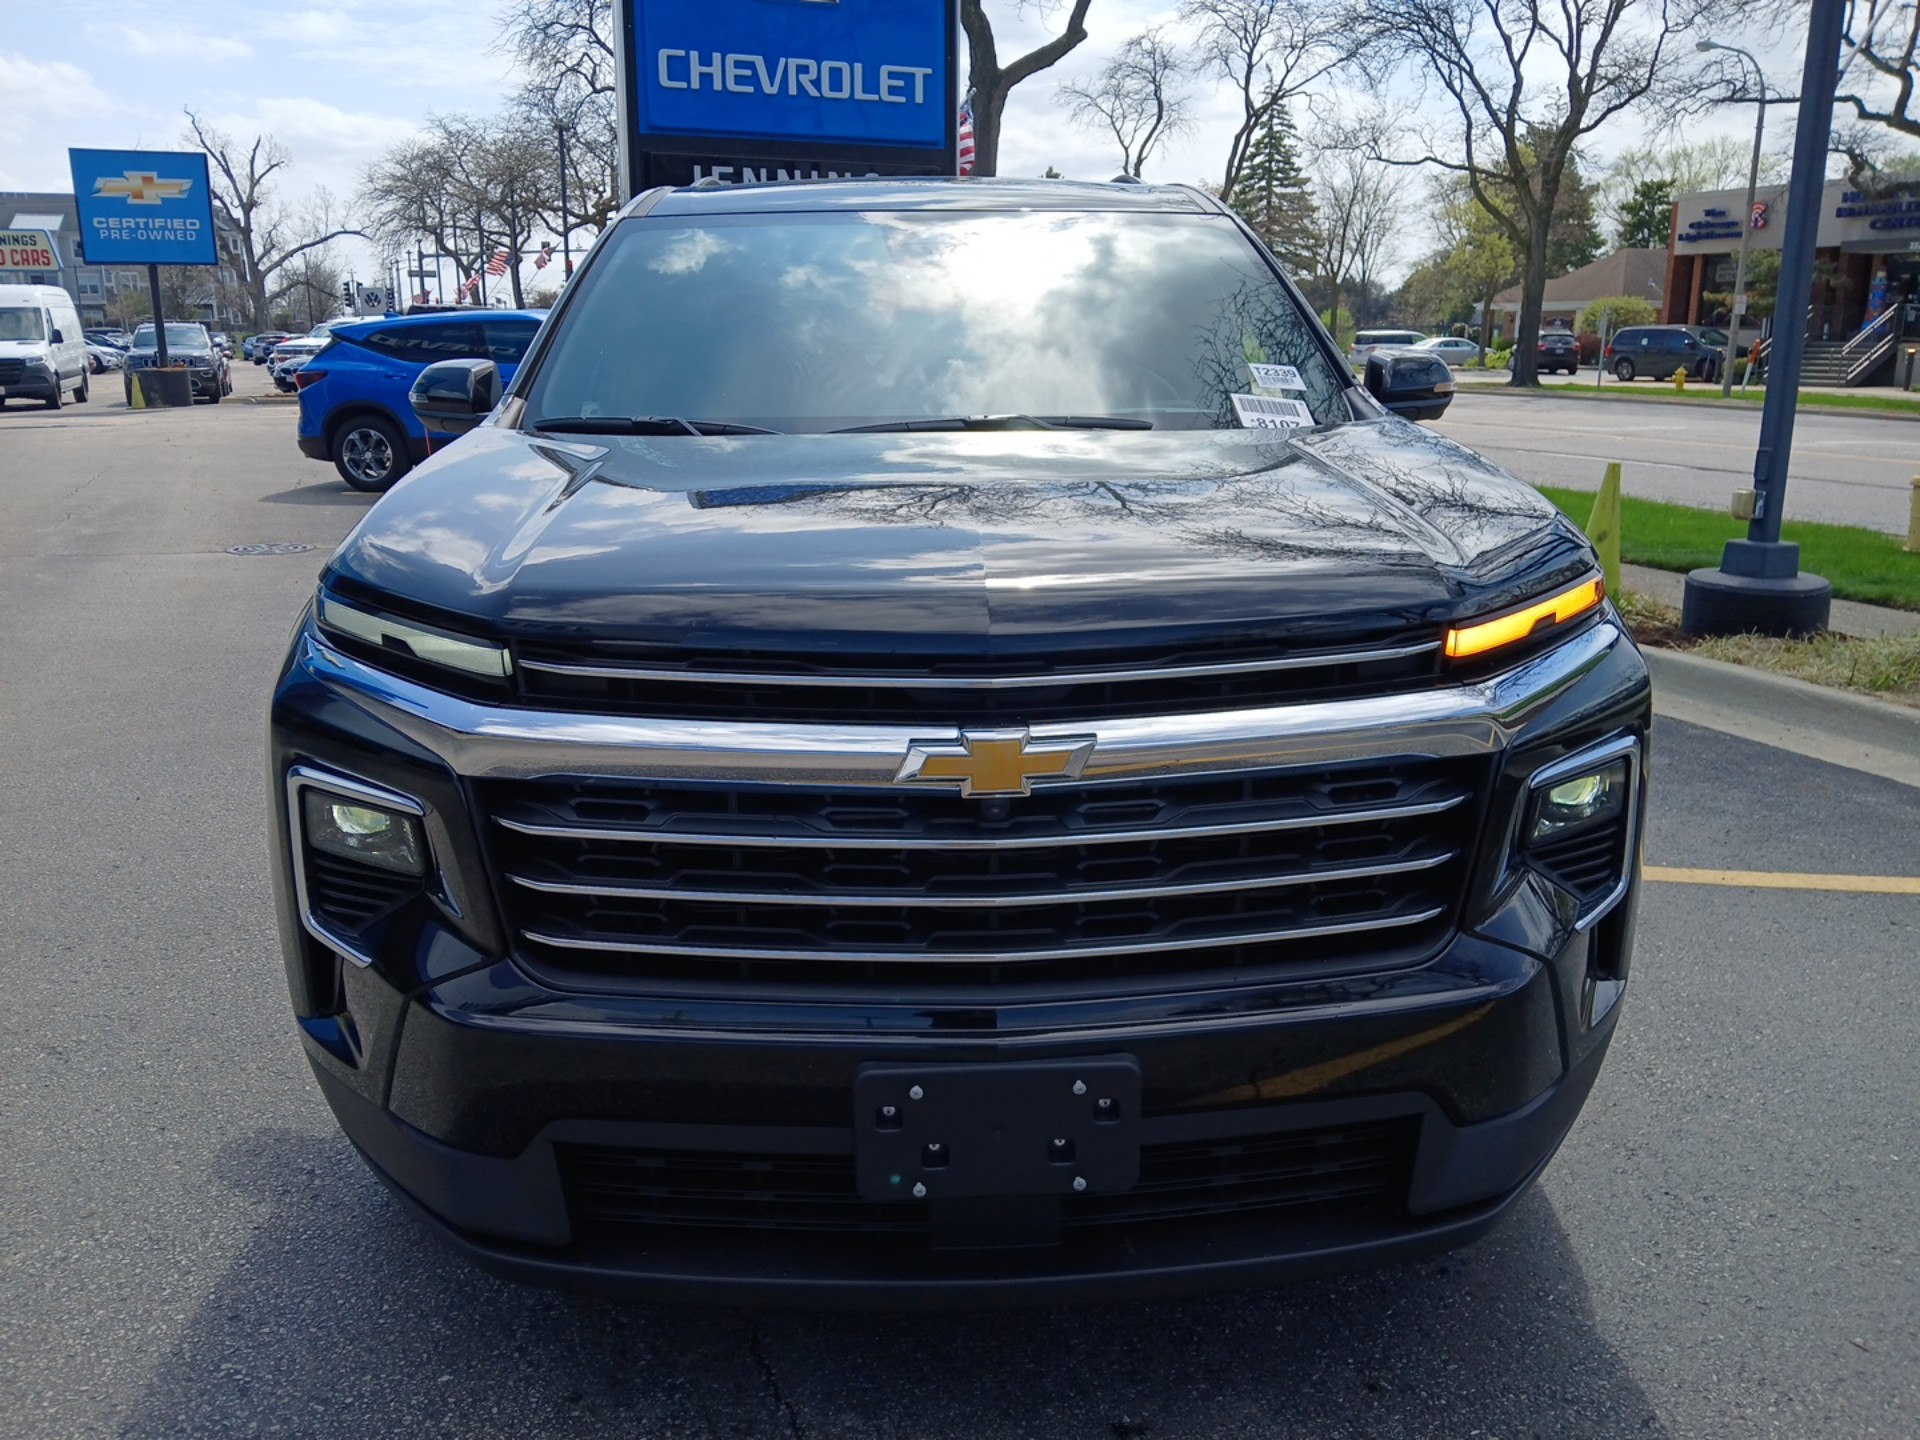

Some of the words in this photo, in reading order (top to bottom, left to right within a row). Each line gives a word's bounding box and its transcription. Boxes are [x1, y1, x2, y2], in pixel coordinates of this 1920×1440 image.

[658, 48, 933, 104] CHEVROLET
[92, 217, 200, 229] CERTIFIED
[100, 229, 196, 240] PRE-OWNED
[11, 249, 51, 266] CARS
[1253, 366, 1297, 378] T2339
